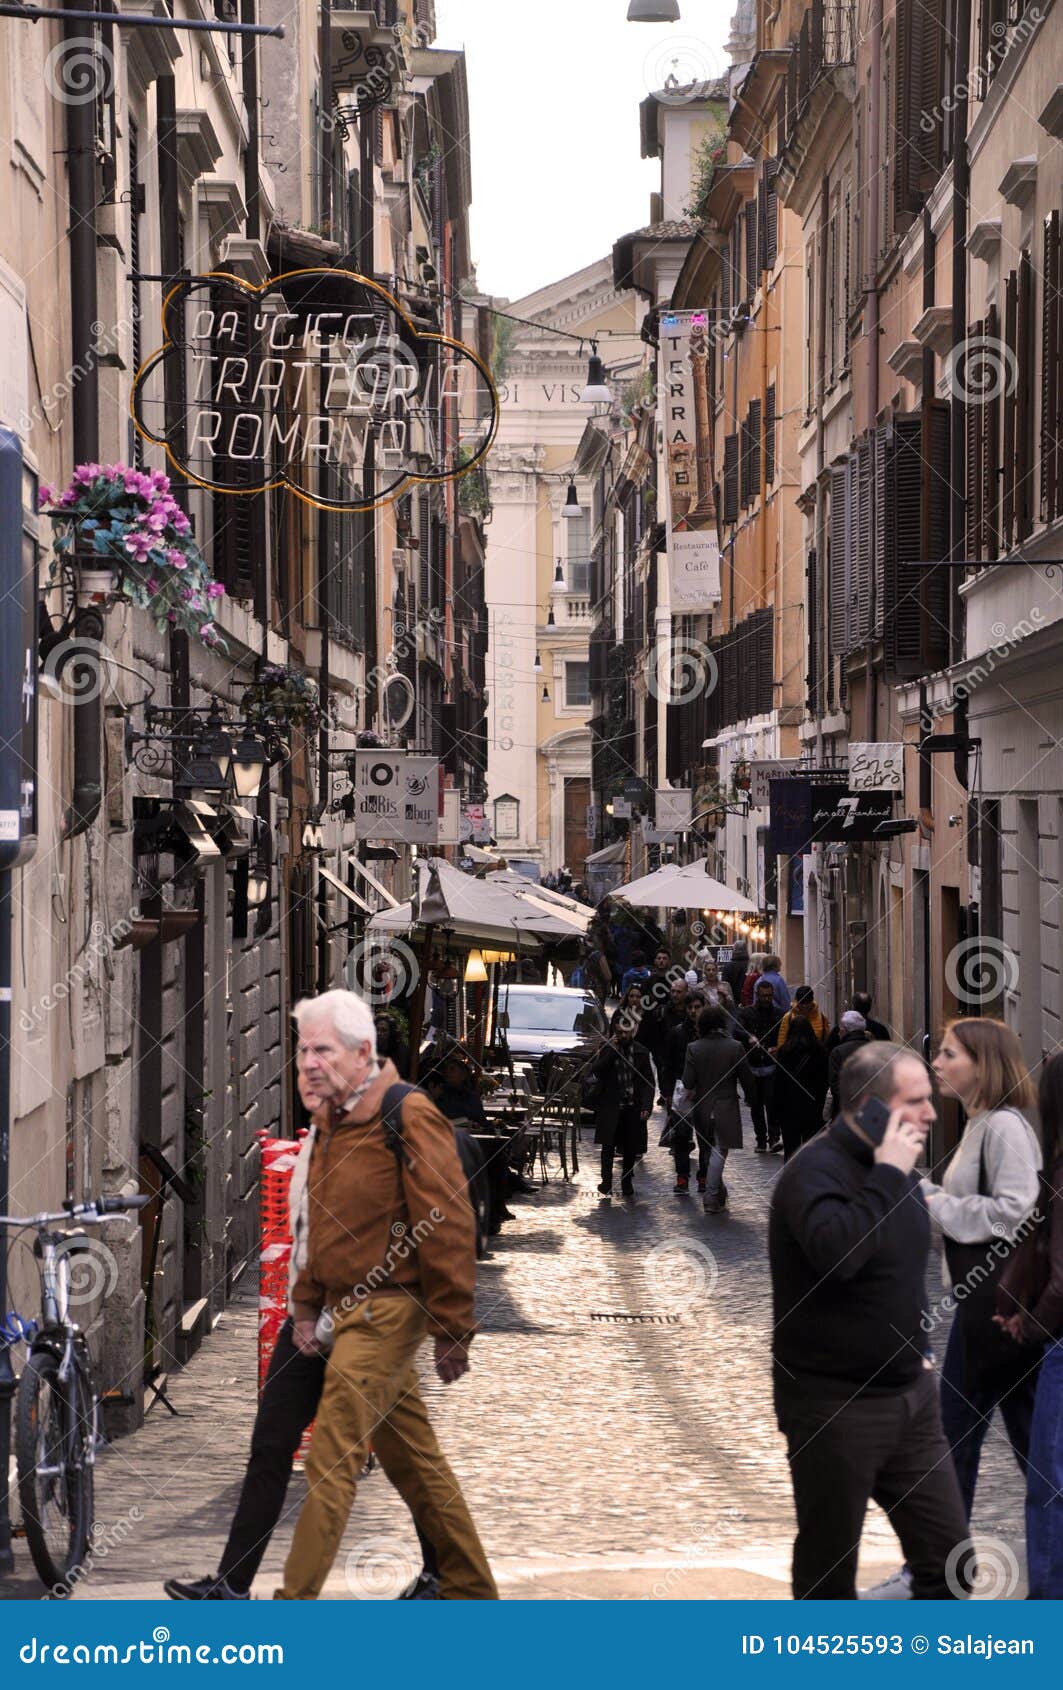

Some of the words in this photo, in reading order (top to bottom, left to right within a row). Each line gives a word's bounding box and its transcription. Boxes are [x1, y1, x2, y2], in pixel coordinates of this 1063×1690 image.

[191, 310, 238, 342] DA
[192, 355, 467, 413] TRATTORIA
[667, 336, 690, 486] TERRACE
[187, 410, 408, 463] ROMANA
[673, 542, 719, 551] Restaurant
[848, 805, 892, 817] mankind
